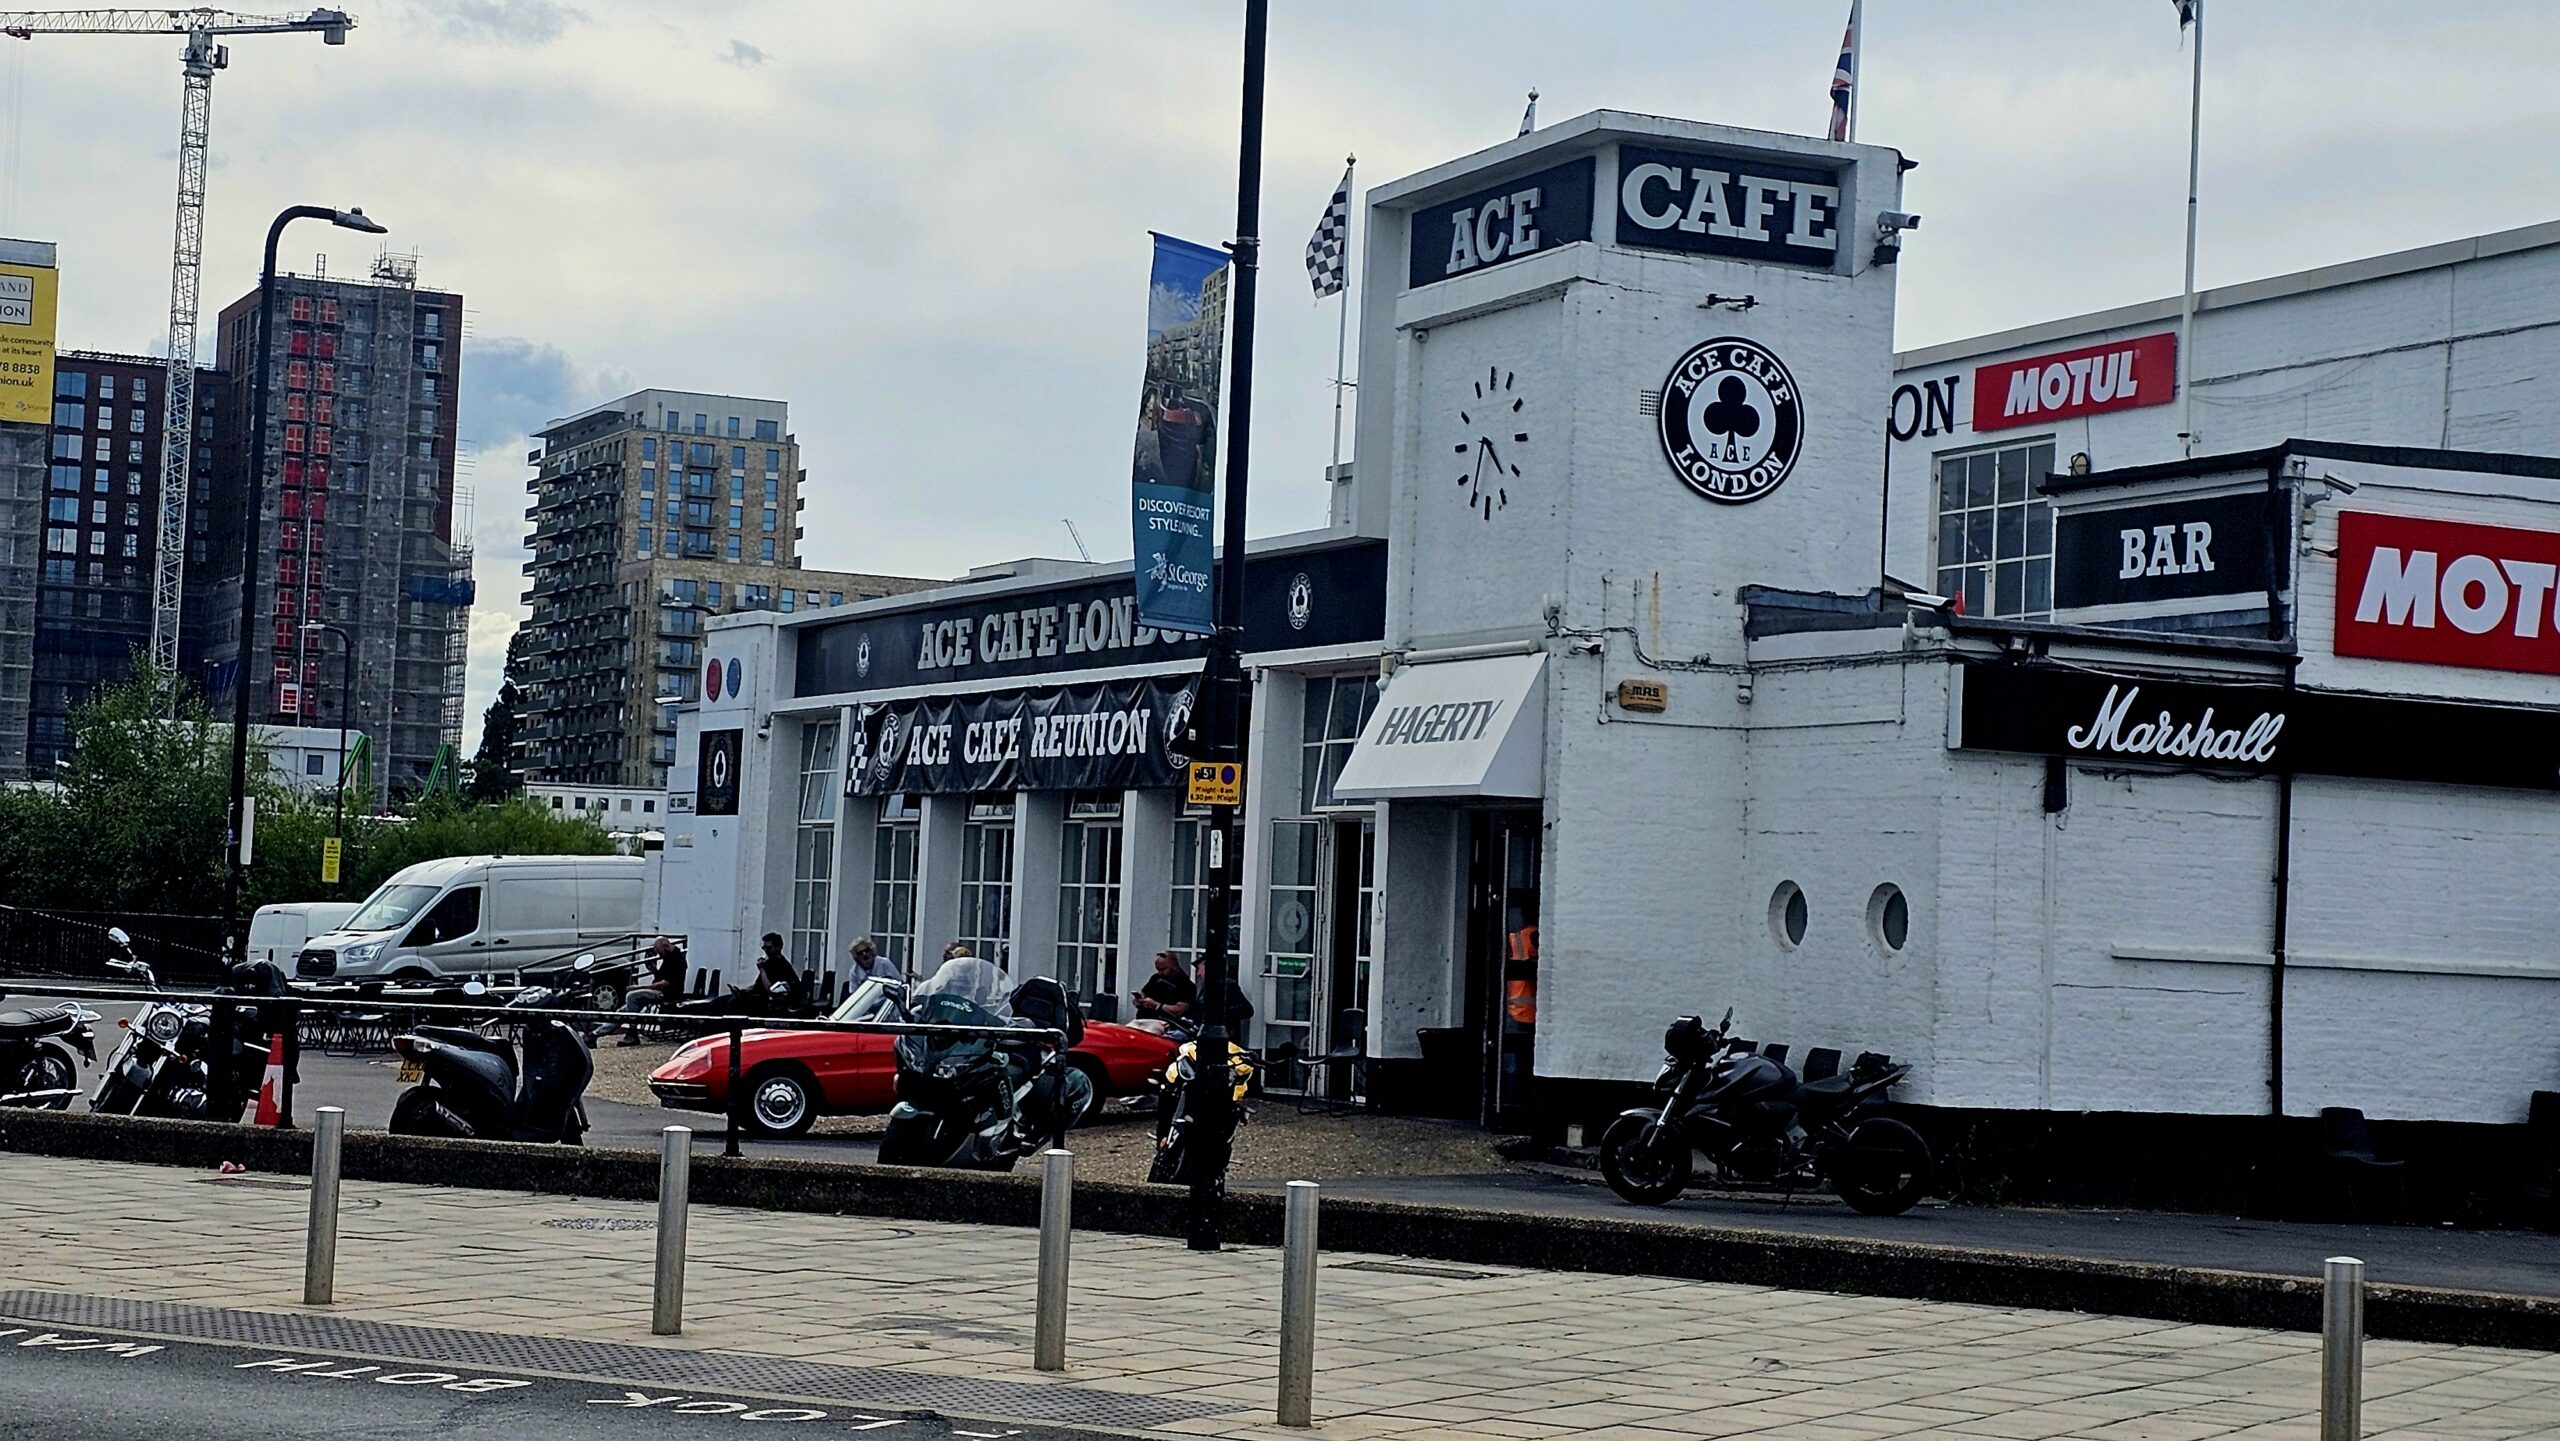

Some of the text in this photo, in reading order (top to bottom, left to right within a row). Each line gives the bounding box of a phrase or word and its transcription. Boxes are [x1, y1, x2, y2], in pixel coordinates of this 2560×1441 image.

[1446, 187, 1541, 274] ACE
[1622, 163, 1839, 250] CAFE
[12, 362, 40, 375] 8838
[1675, 349, 1791, 405] ACE CAFE
[2003, 350, 2138, 417] MOTUL
[1676, 443, 1784, 494] LONDON
[1176, 565, 1209, 593] George
[2119, 522, 2215, 580] BAR
[2355, 546, 2560, 639] MOT
[918, 617, 973, 670] ACE
[980, 605, 1059, 663] CAFE
[1065, 595, 1209, 654] LON
[907, 724, 952, 765] ACE
[963, 718, 1022, 764] CAFE
[1030, 709, 1150, 758] REUNION
[1375, 699, 1504, 746] HAGERTY
[2067, 684, 2286, 763] Marshall
[234, 1358, 533, 1392] BOTH
